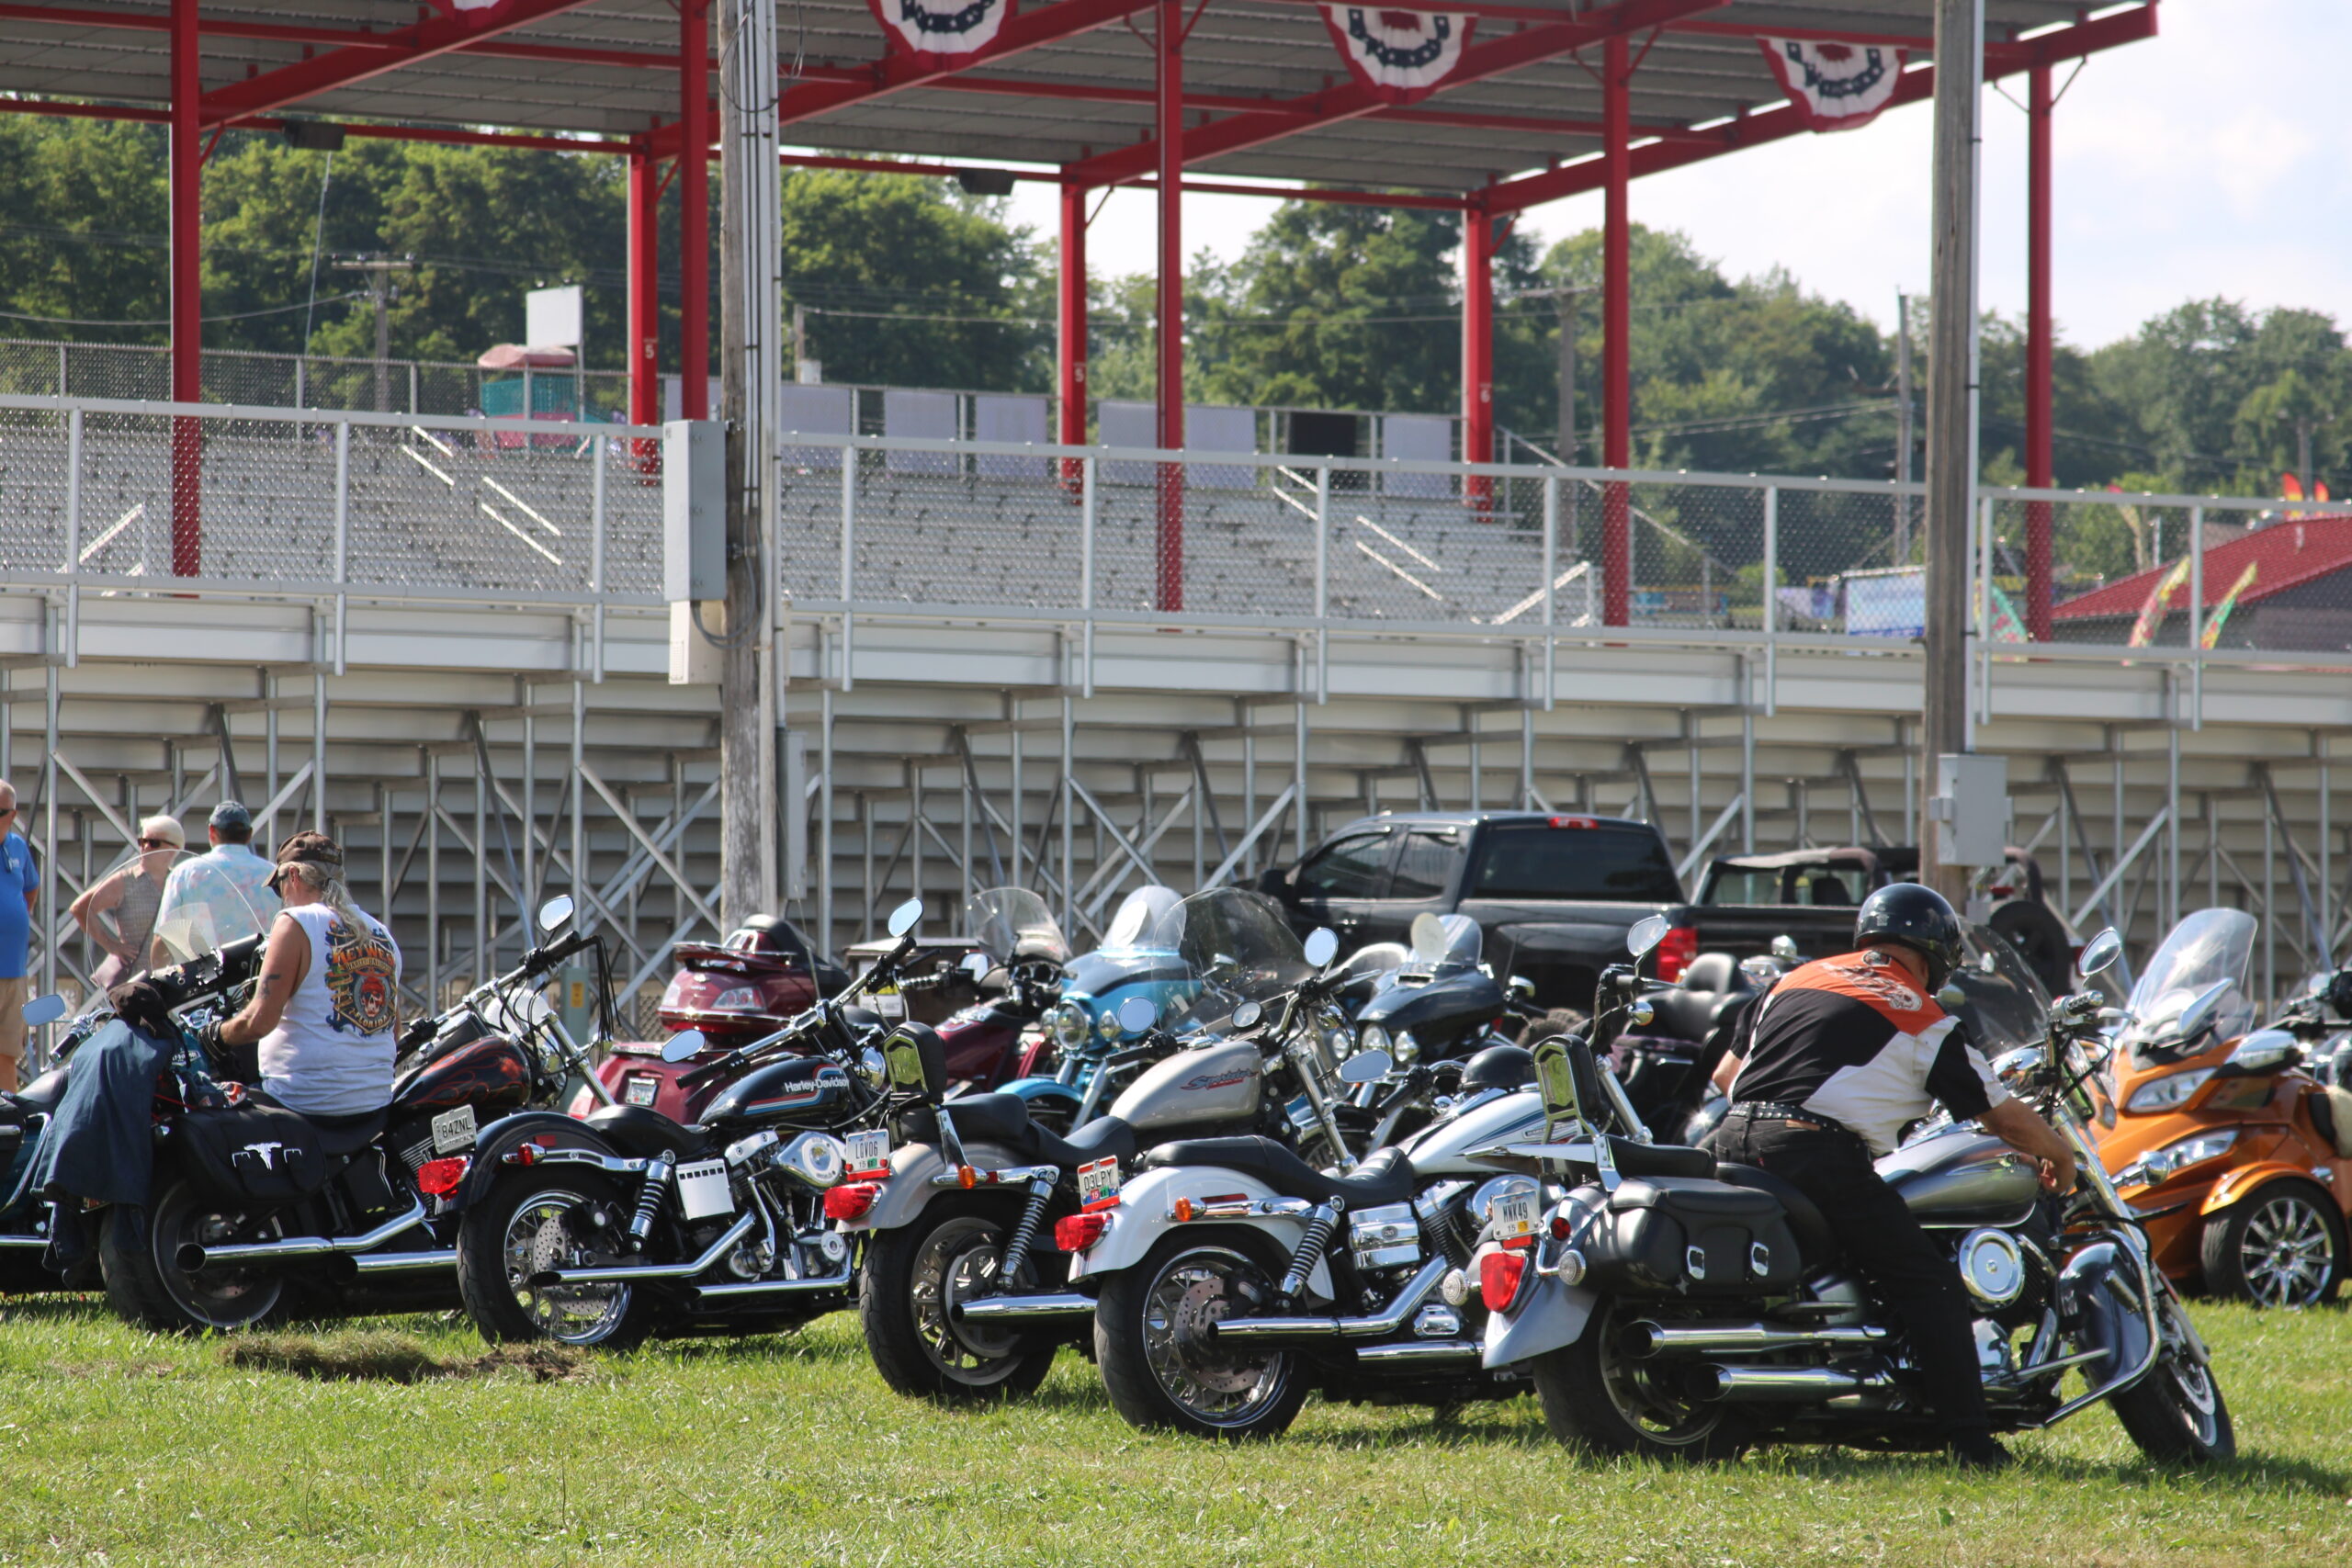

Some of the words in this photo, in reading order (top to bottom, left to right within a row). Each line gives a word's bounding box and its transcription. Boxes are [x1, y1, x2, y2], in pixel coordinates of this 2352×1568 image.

[645, 344, 654, 359] 5
[785, 1077, 849, 1092] Harley-Davidson
[1180, 1067, 1260, 1090] Sportster
[441, 1117, 472, 1138] 84ZNL
[1084, 1168, 1112, 1190] 03LPY
[1503, 1202, 1528, 1223] MNK49
[1508, 1224, 1516, 1233] 15
